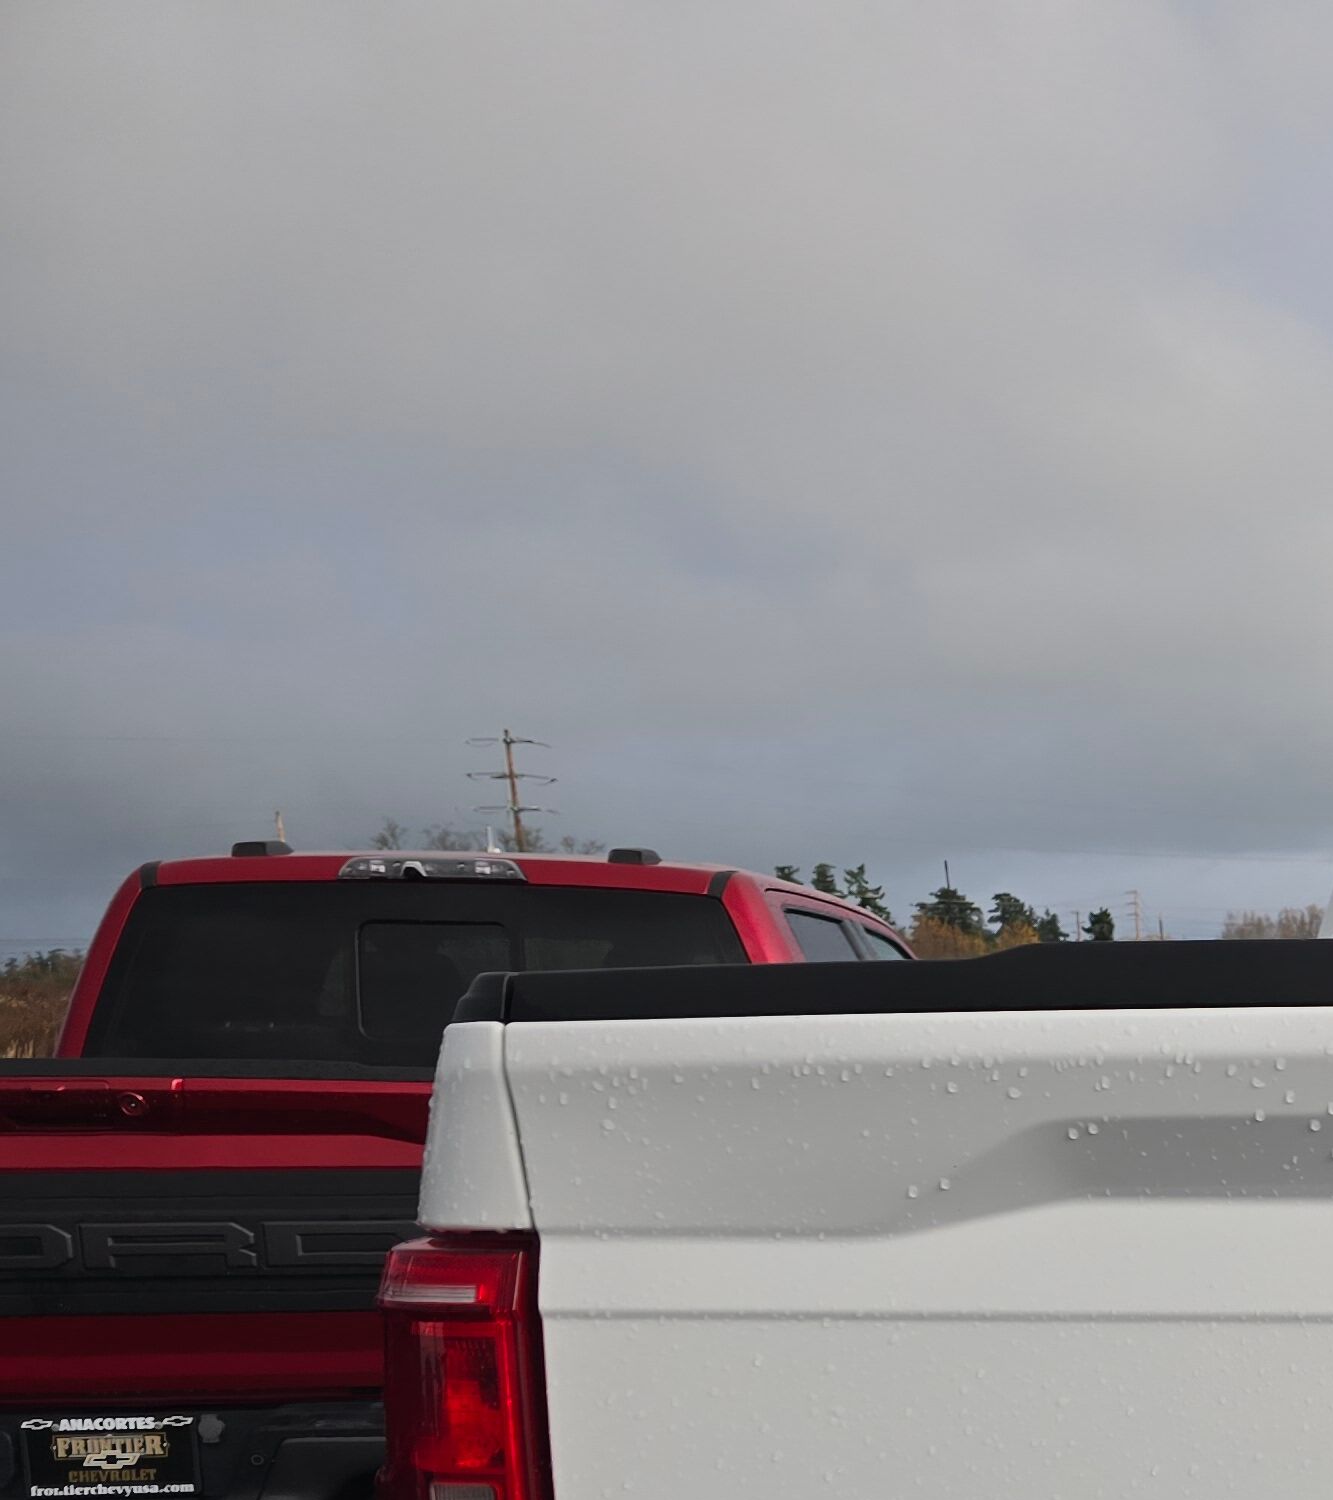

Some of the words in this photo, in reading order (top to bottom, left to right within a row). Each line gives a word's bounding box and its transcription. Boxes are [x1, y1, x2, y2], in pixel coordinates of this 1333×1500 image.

[58, 1417, 155, 1431] ANACORTES
[56, 1435, 164, 1458] FRONTIER
[68, 1469, 157, 1482] CHEVROLET
